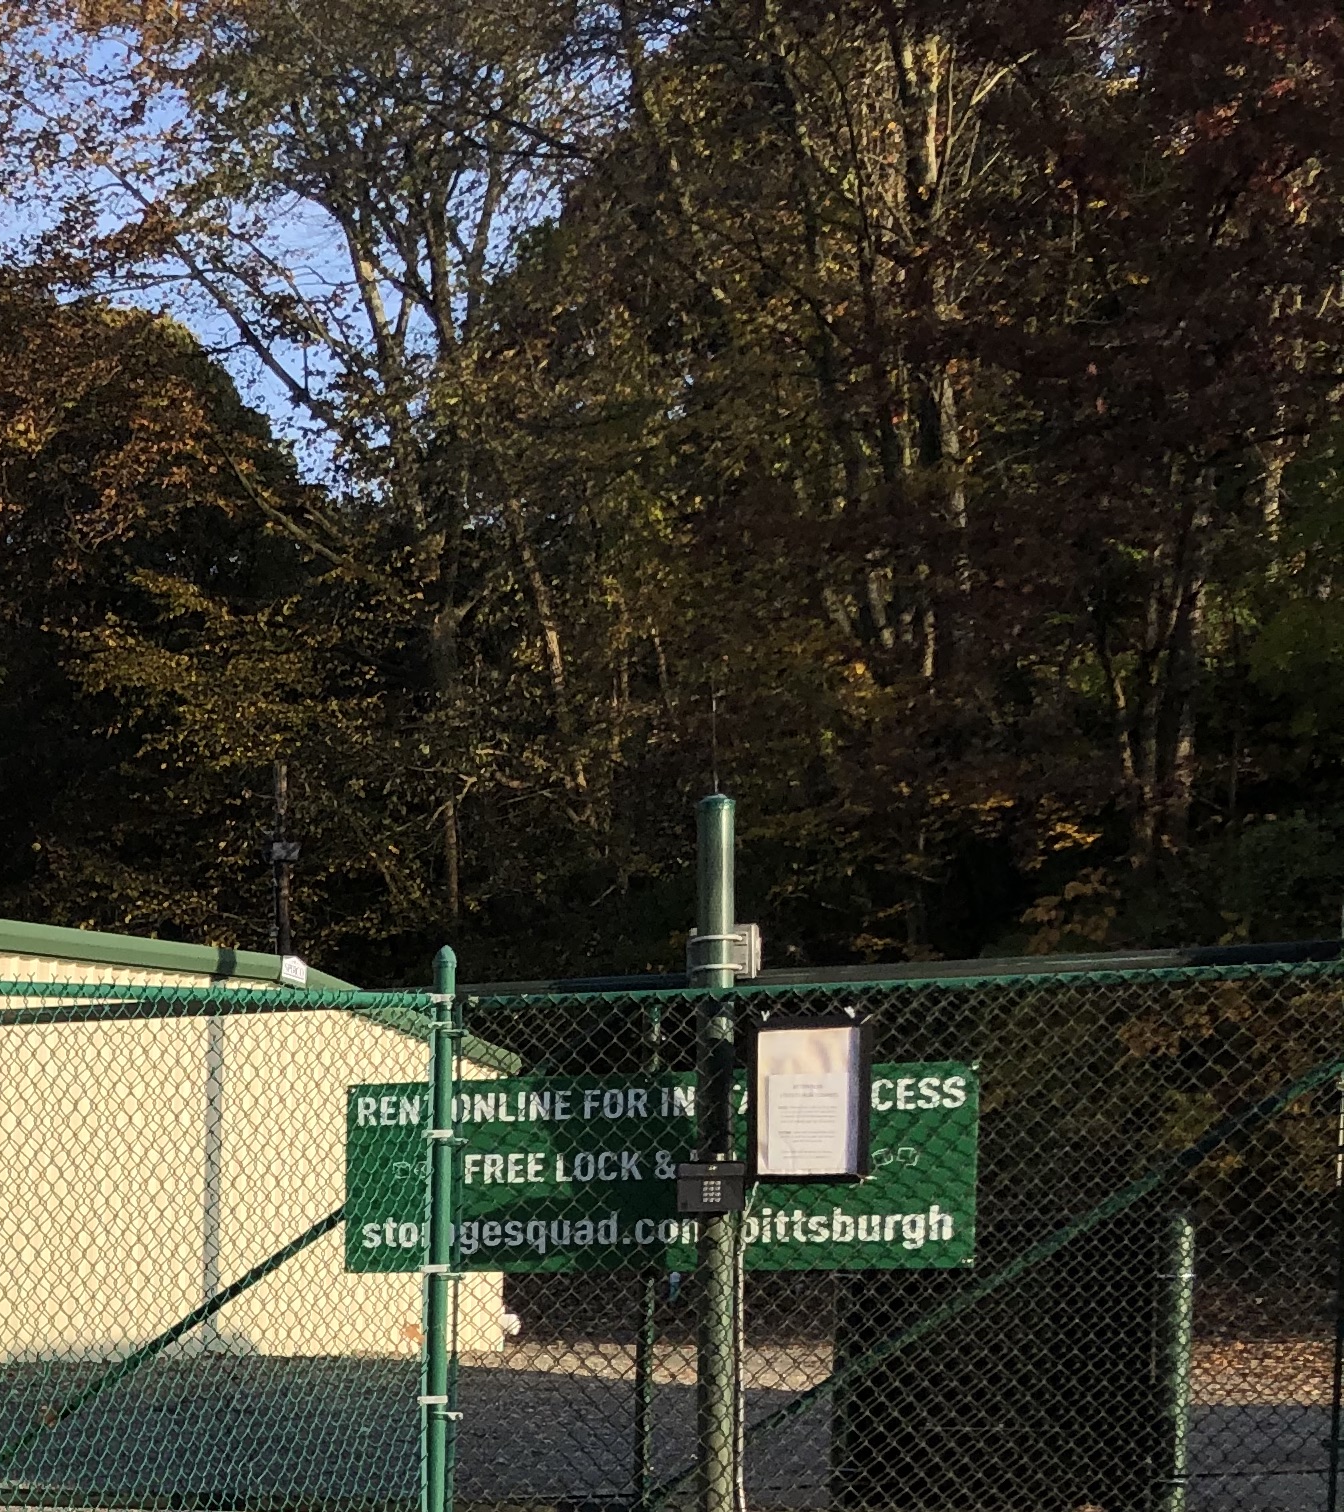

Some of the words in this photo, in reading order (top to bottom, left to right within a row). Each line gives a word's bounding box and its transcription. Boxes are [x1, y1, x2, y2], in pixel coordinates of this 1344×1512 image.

[357, 1094, 430, 1127] REN
[451, 1089, 572, 1123] ONLINE
[583, 1088, 648, 1119] FOR
[870, 1075, 967, 1112] CESS
[464, 1153, 546, 1184] FREE
[555, 1150, 643, 1182] LOCK
[654, 1149, 676, 1180] &
